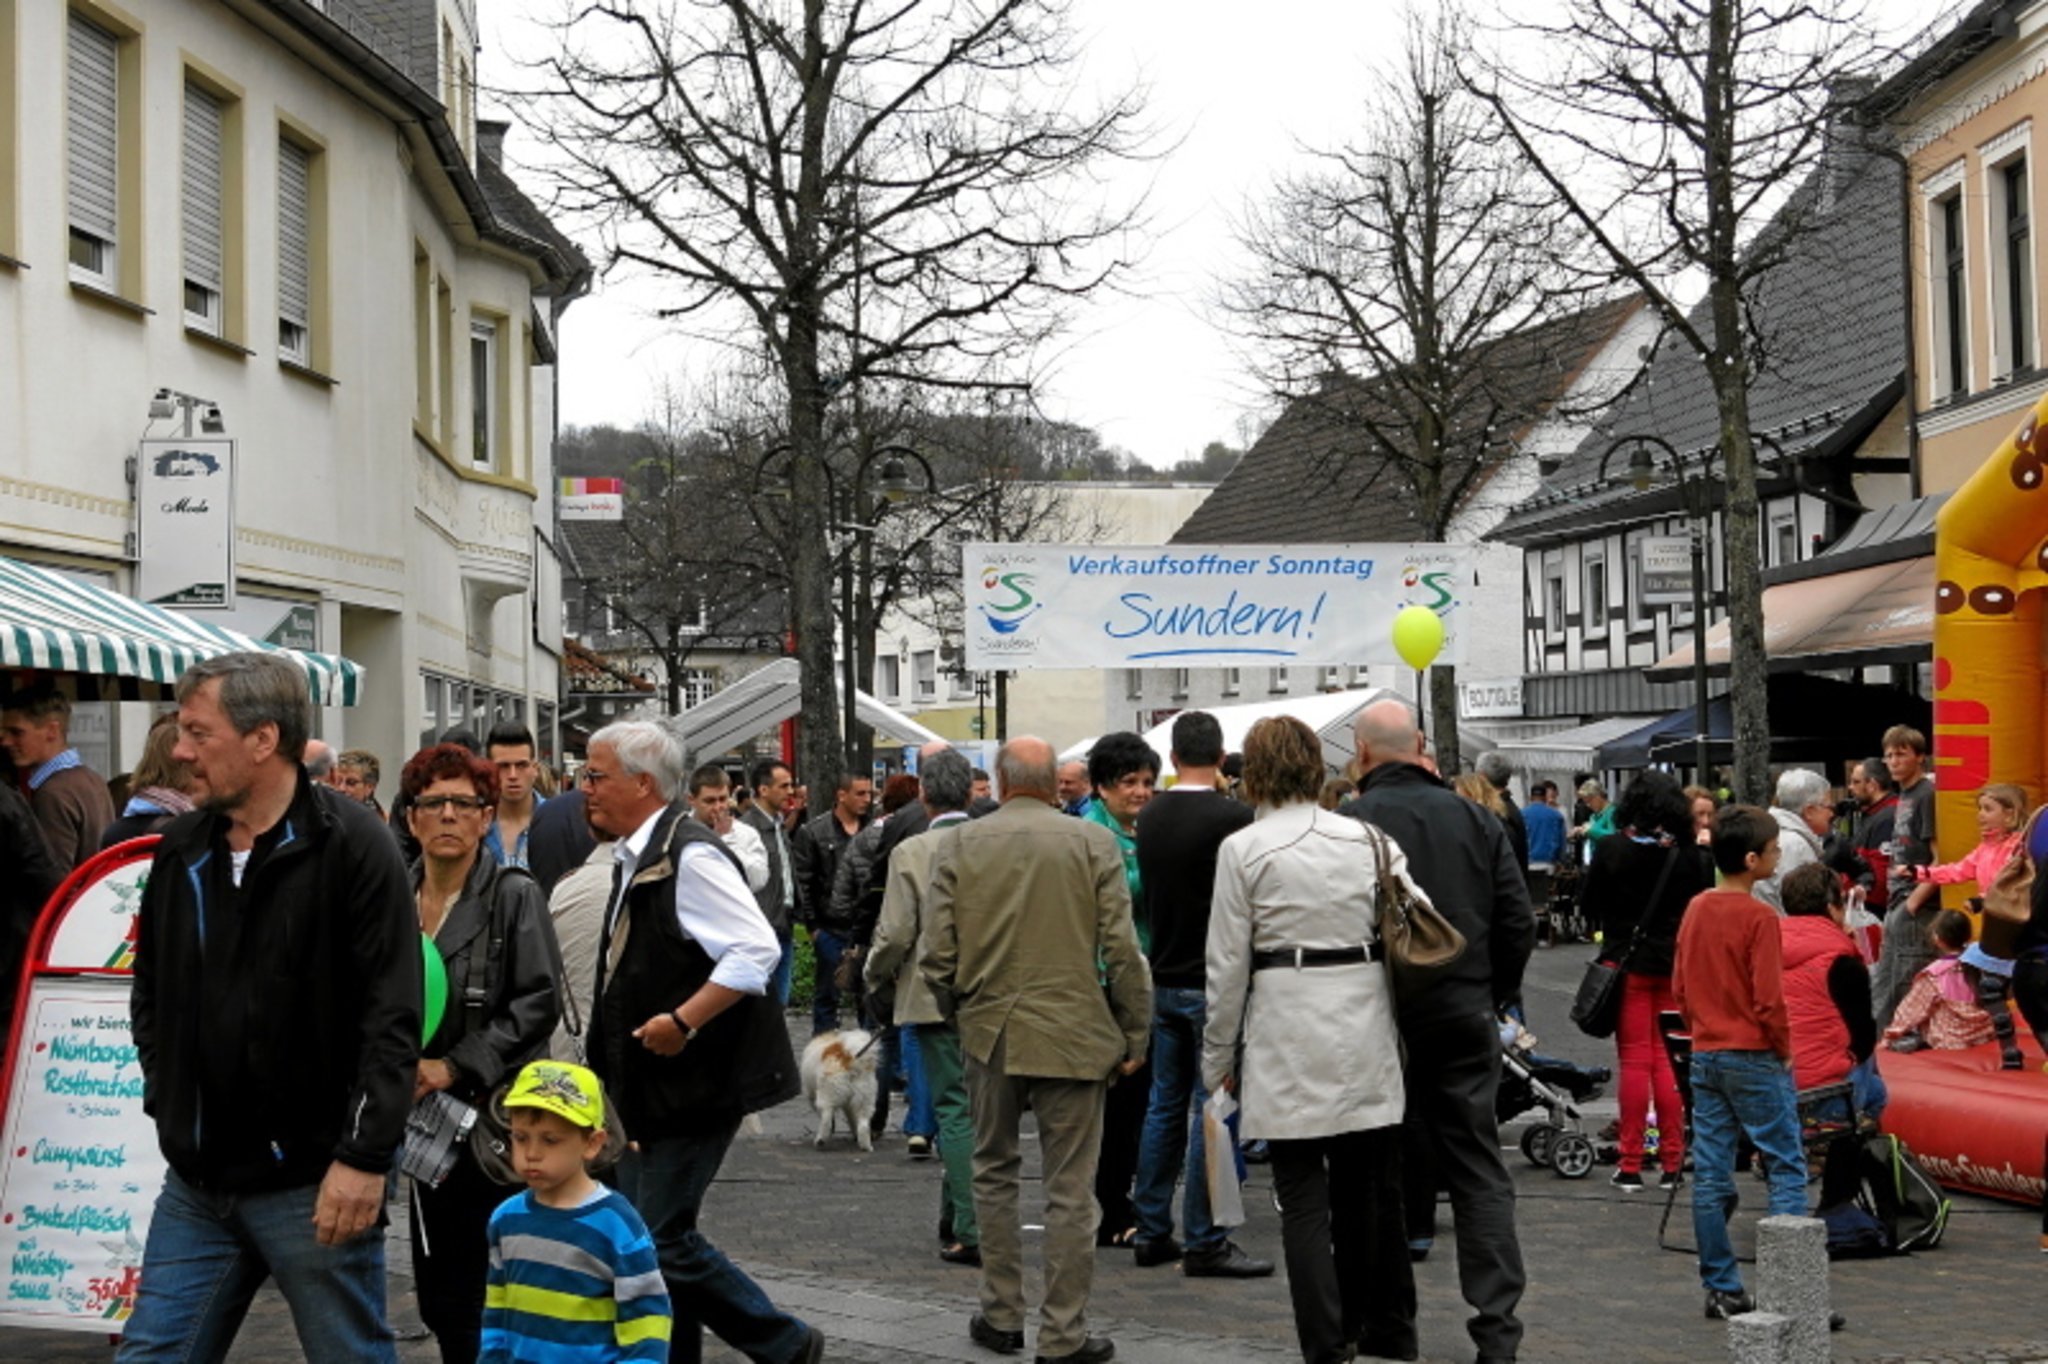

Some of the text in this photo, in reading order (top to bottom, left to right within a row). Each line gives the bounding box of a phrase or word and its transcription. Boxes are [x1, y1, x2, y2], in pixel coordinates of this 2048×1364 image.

[1069, 555, 1375, 580] Verkaufsoffner Sonntag
[1104, 590, 1327, 639] Sundern!
[1469, 686, 1519, 707] BOUTIQUE
